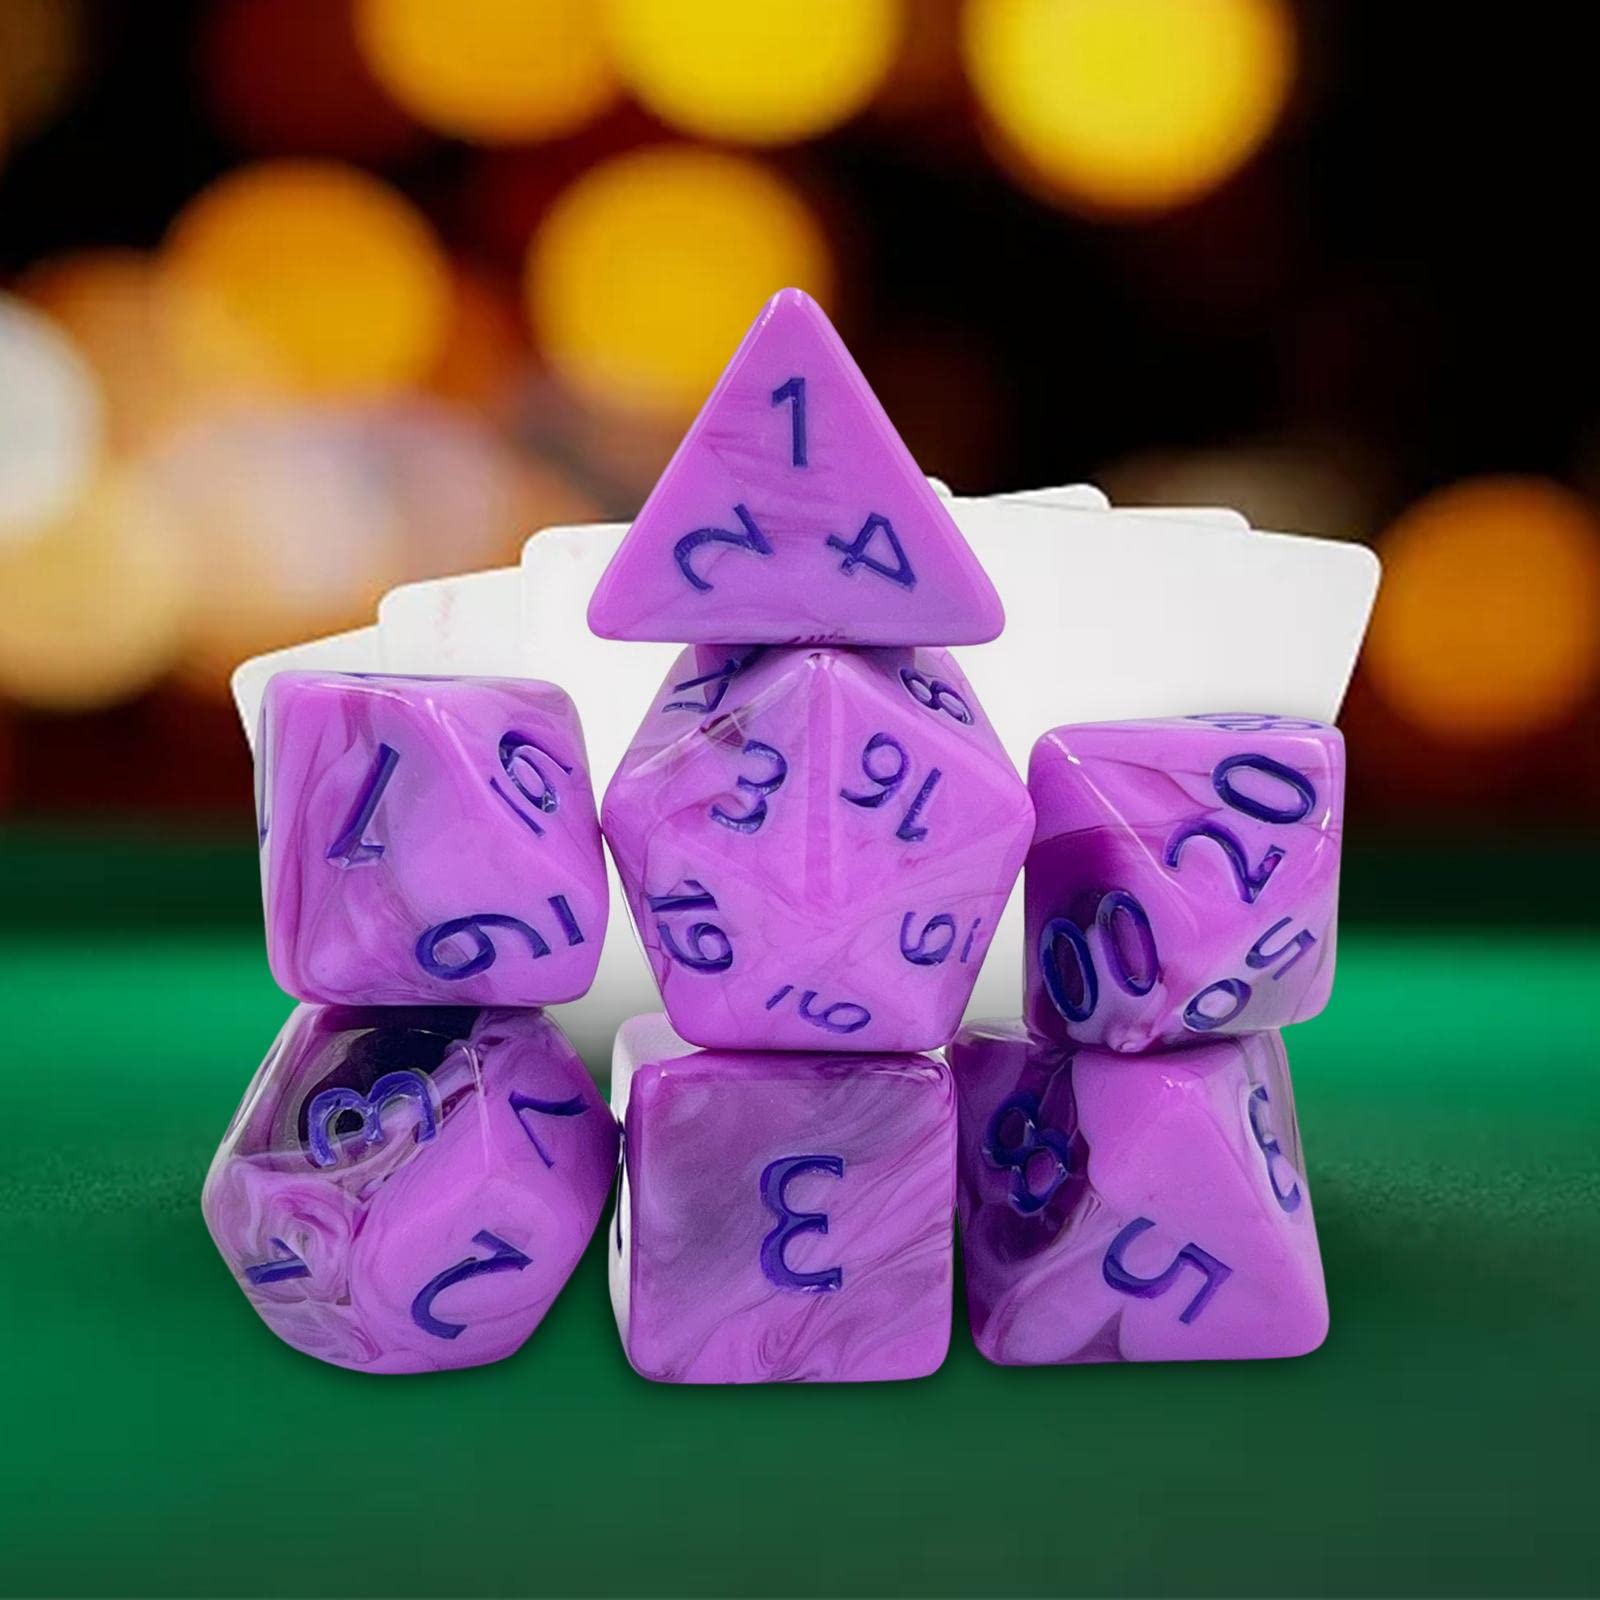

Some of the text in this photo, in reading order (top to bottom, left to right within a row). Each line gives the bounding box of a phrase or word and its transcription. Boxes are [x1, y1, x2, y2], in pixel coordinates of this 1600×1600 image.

[771, 376, 809, 468] 1
[673, 503, 776, 592] 2
[825, 512, 918, 593] 4
[900, 666, 976, 726] 8
[709, 738, 788, 836] 3
[839, 731, 943, 842] 16
[1162, 752, 1318, 905] 20
[644, 878, 735, 975] 19
[1038, 889, 1161, 1023] 00
[1182, 915, 1319, 1032] 50
[307, 1069, 440, 1170] 3
[980, 1088, 1072, 1218] 8
[1247, 1083, 1302, 1216] 3
[759, 1154, 844, 1294] 3
[1101, 1215, 1235, 1327] 5
[410, 1228, 535, 1341] 2
